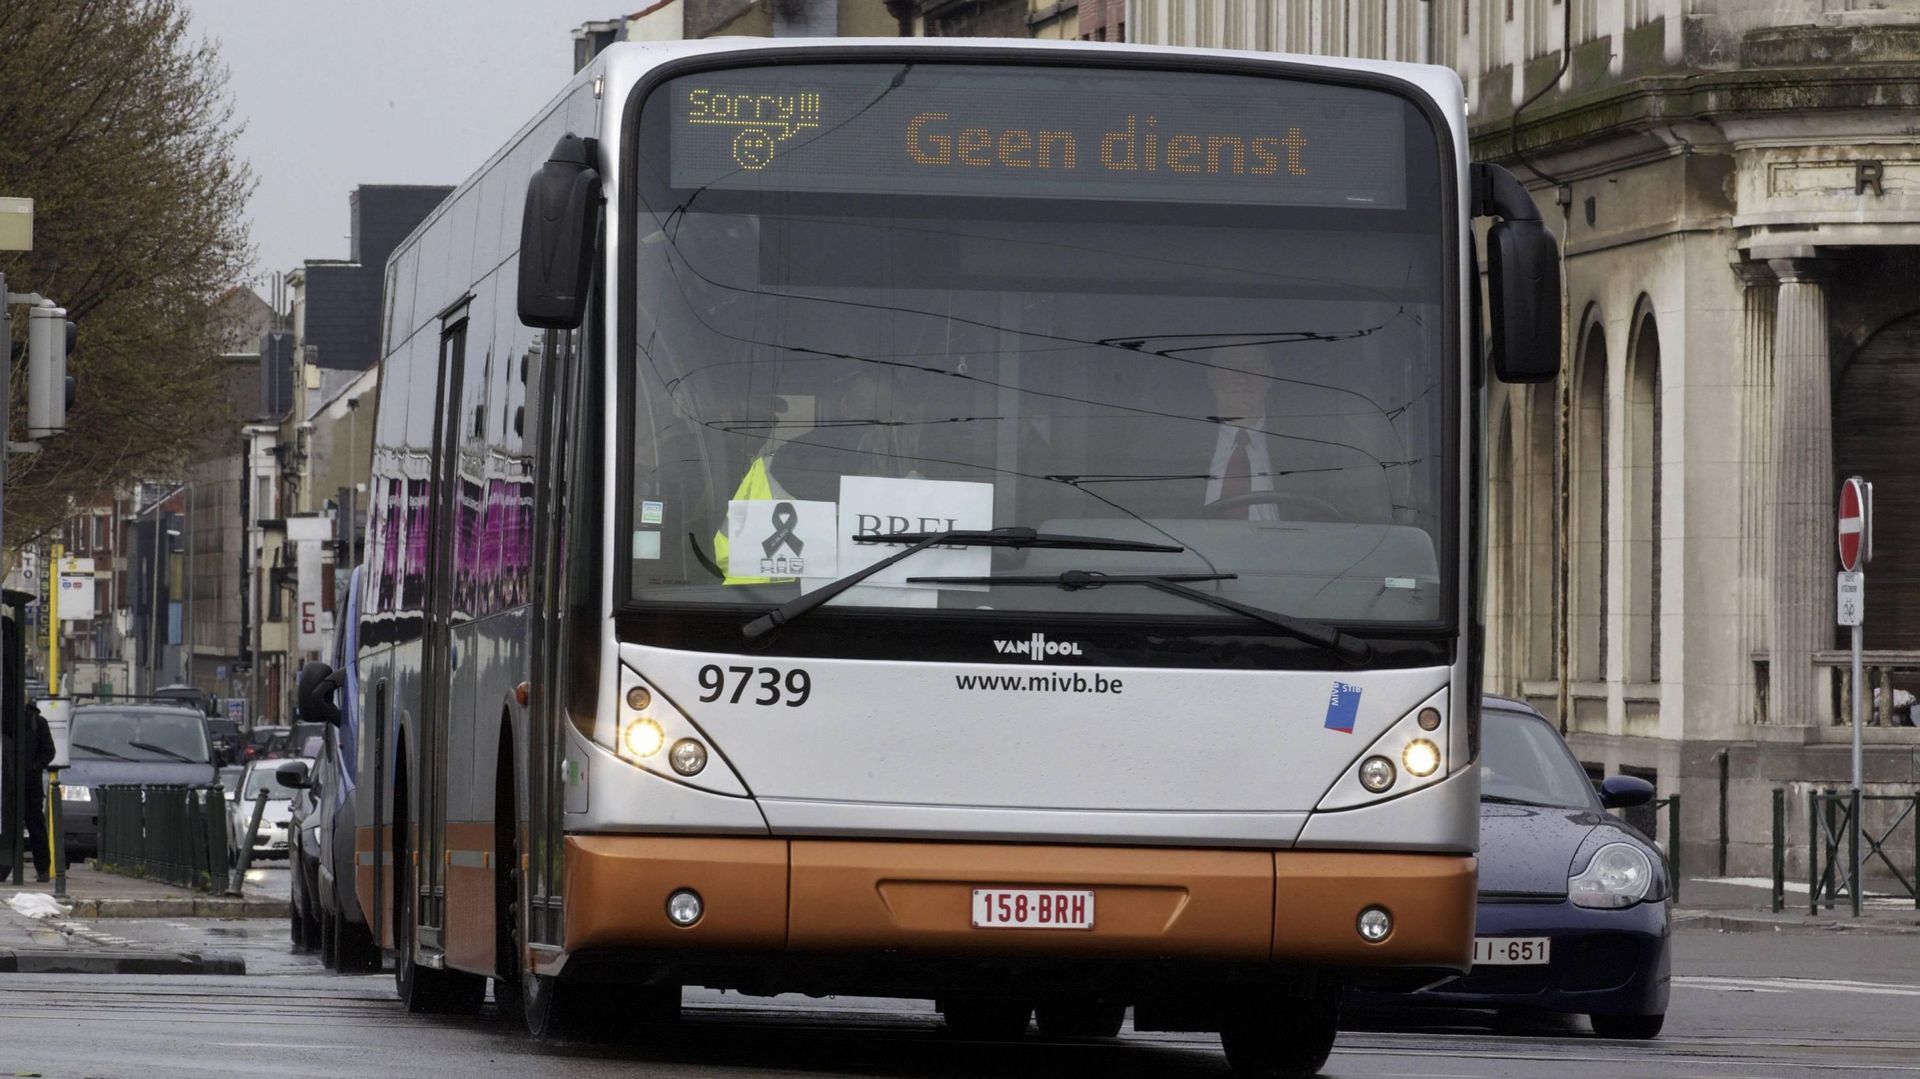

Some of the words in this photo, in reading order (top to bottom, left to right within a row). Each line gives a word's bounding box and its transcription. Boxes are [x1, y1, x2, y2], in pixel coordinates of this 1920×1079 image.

[689, 89, 820, 119] Sorry!!!
[905, 111, 1077, 169] Geen
[1100, 113, 1310, 176] dienst
[1855, 160, 1883, 196] R
[856, 513, 968, 550] BREL
[698, 664, 811, 707] 9739
[955, 673, 1123, 694] www.mivb.be
